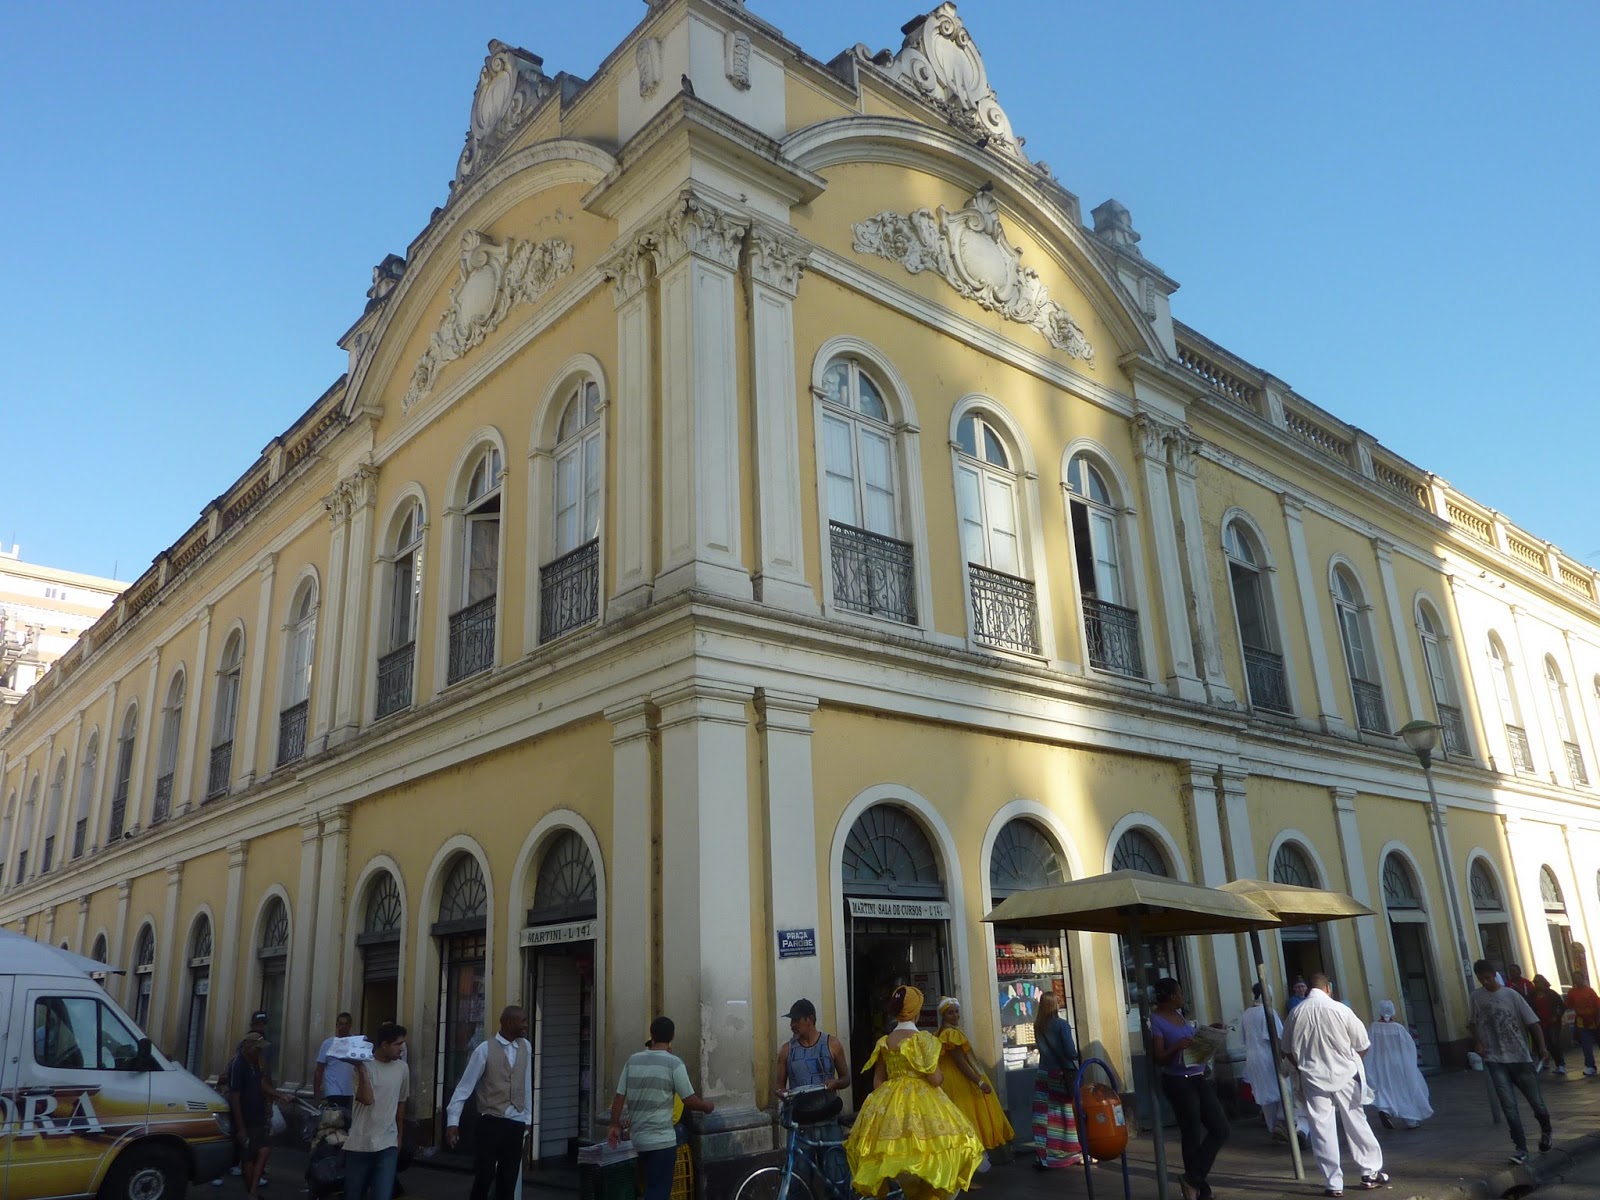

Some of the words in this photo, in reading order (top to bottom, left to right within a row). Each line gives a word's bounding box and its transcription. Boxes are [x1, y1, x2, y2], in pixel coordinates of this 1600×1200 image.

[852, 902, 876, 915] MARTINI
[527, 929, 562, 944] MARTINI
[568, 927, 574, 939] L
[576, 925, 591, 937] 141
[786, 931, 809, 940] PRAÇA
[1014, 1001, 1032, 1017] 141
